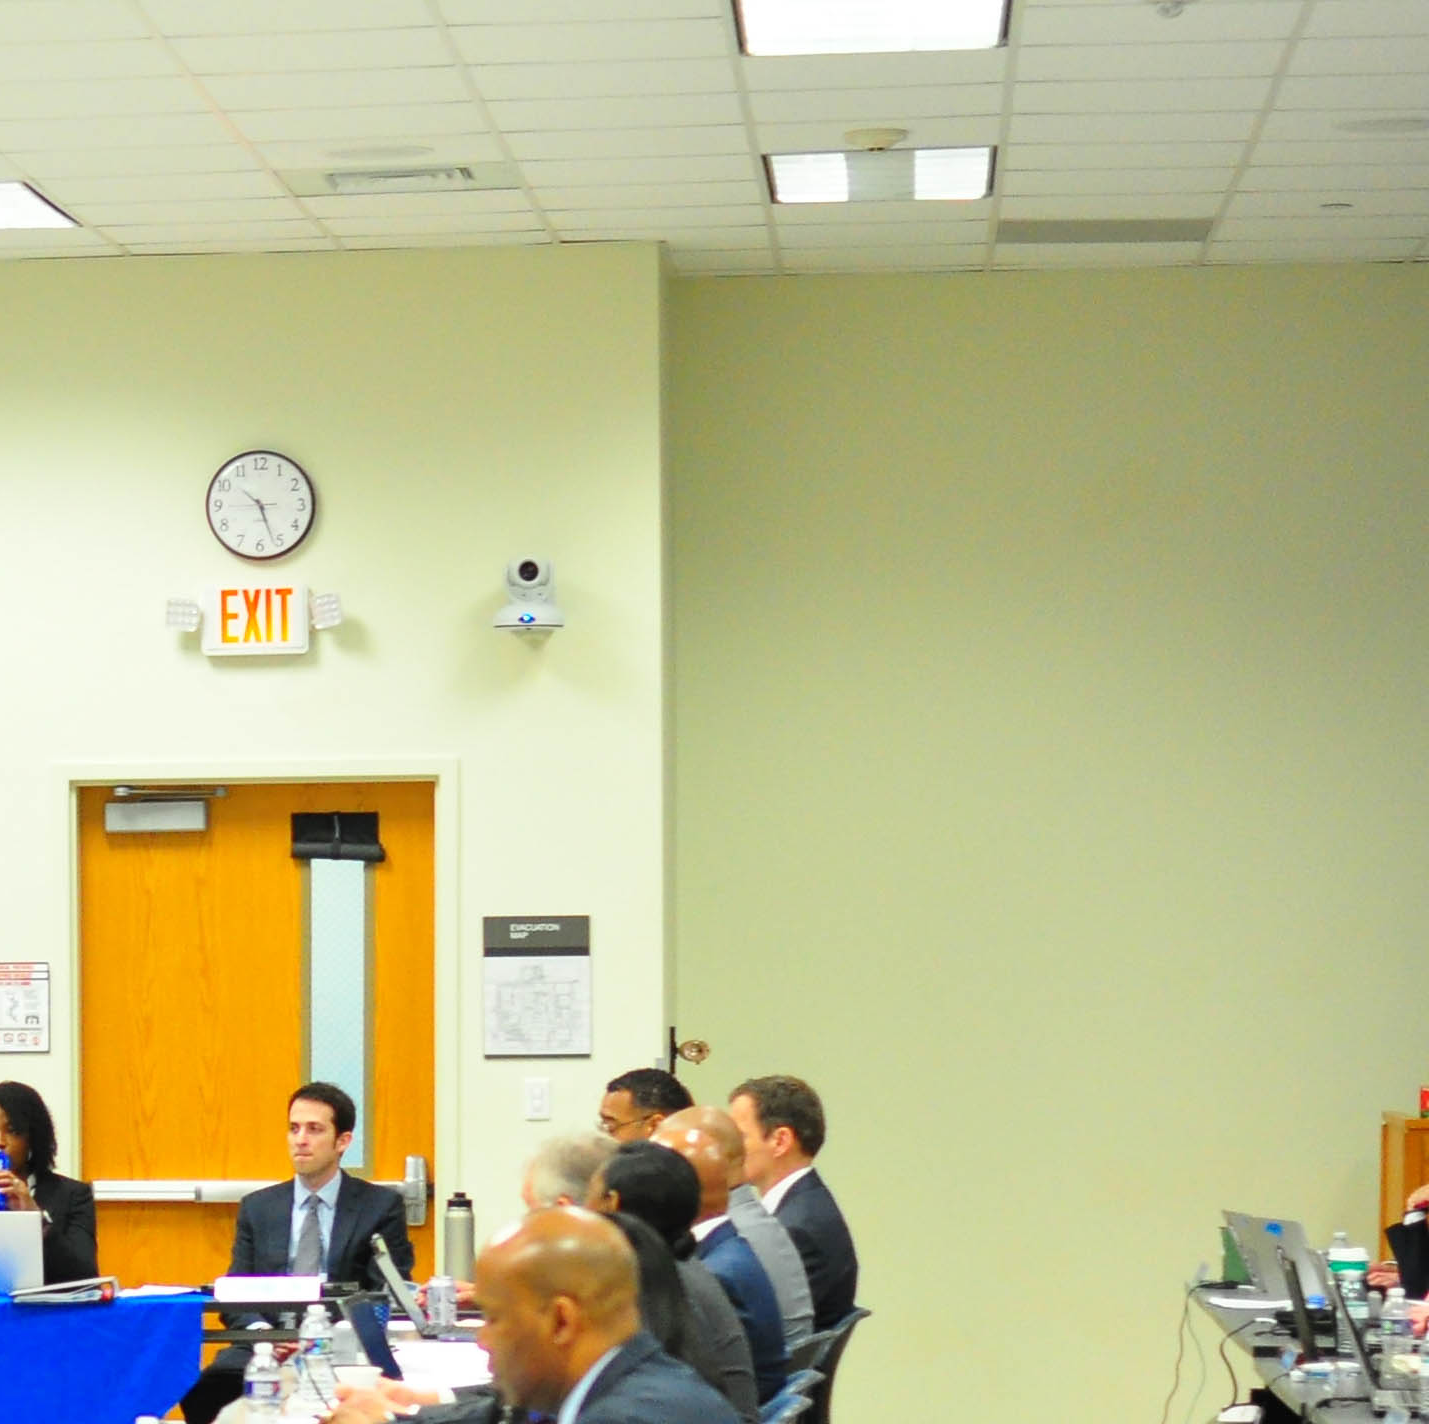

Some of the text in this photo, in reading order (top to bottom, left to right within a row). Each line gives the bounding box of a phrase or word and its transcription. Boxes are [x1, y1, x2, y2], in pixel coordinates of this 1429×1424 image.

[236, 464, 245, 477] 11
[253, 457, 268, 471] 12
[276, 464, 283, 476] 1
[218, 479, 231, 492] 10
[290, 478, 300, 492] 2
[214, 499, 223, 512] 9
[297, 498, 306, 511] 3
[220, 518, 229, 531] 8
[290, 519, 300, 531] 4
[237, 534, 245, 548] 7
[255, 539, 265, 552] 6
[276, 533, 284, 547] 5
[220, 588, 293, 643] EXIT
[509, 923, 560, 931] EVACUATION
